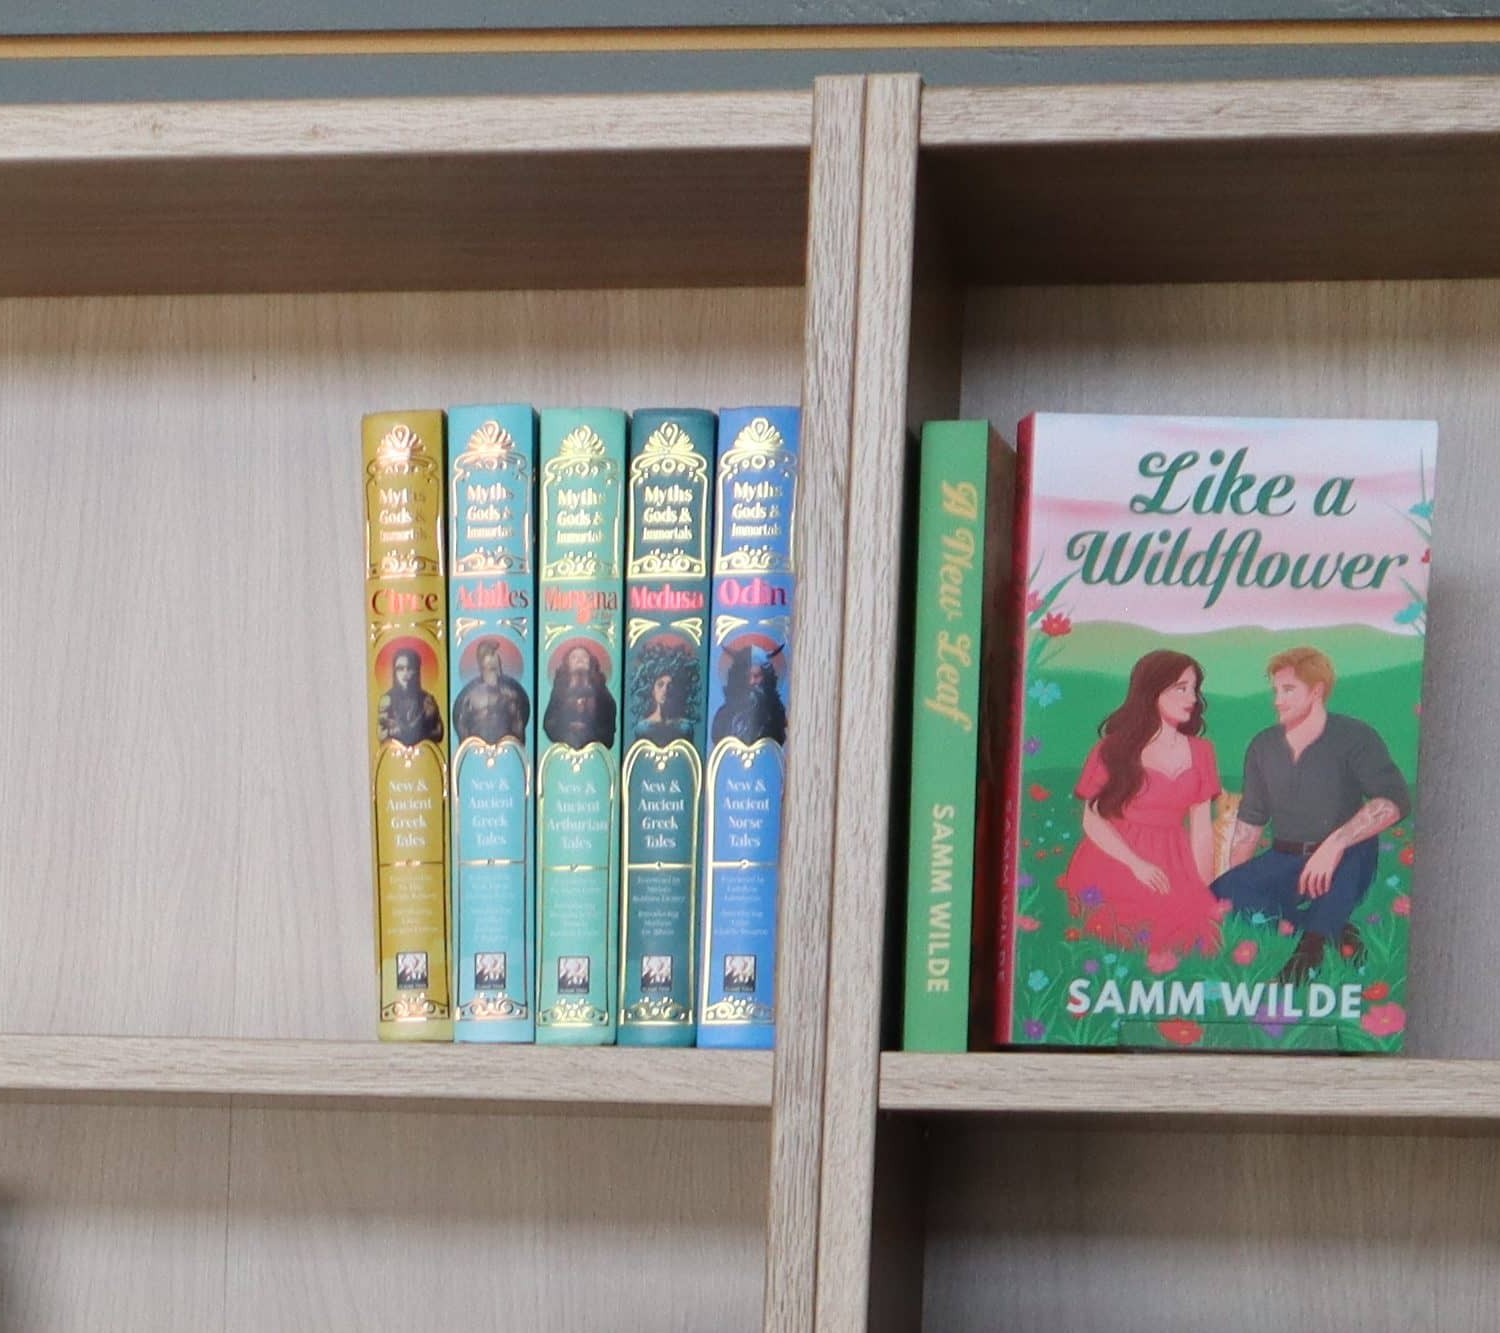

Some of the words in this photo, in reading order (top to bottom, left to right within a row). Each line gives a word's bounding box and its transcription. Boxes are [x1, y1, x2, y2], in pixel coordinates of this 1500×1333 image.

[1129, 444, 1298, 519] Like
[1316, 474, 1358, 516] a
[645, 485, 693, 505] Myths
[645, 507, 676, 522] Gods
[680, 509, 691, 522] &
[644, 527, 692, 541] Immortals
[1065, 525, 1410, 609] Wildflower
[632, 585, 703, 609] Medusa
[641, 779, 668, 794] New
[671, 780, 681, 794] &
[638, 798, 684, 812] Ancient
[642, 816, 678, 831] Greek
[645, 834, 676, 849] Tales
[1065, 979, 1206, 1018] SAMM
[1222, 982, 1363, 1020] WILDE
